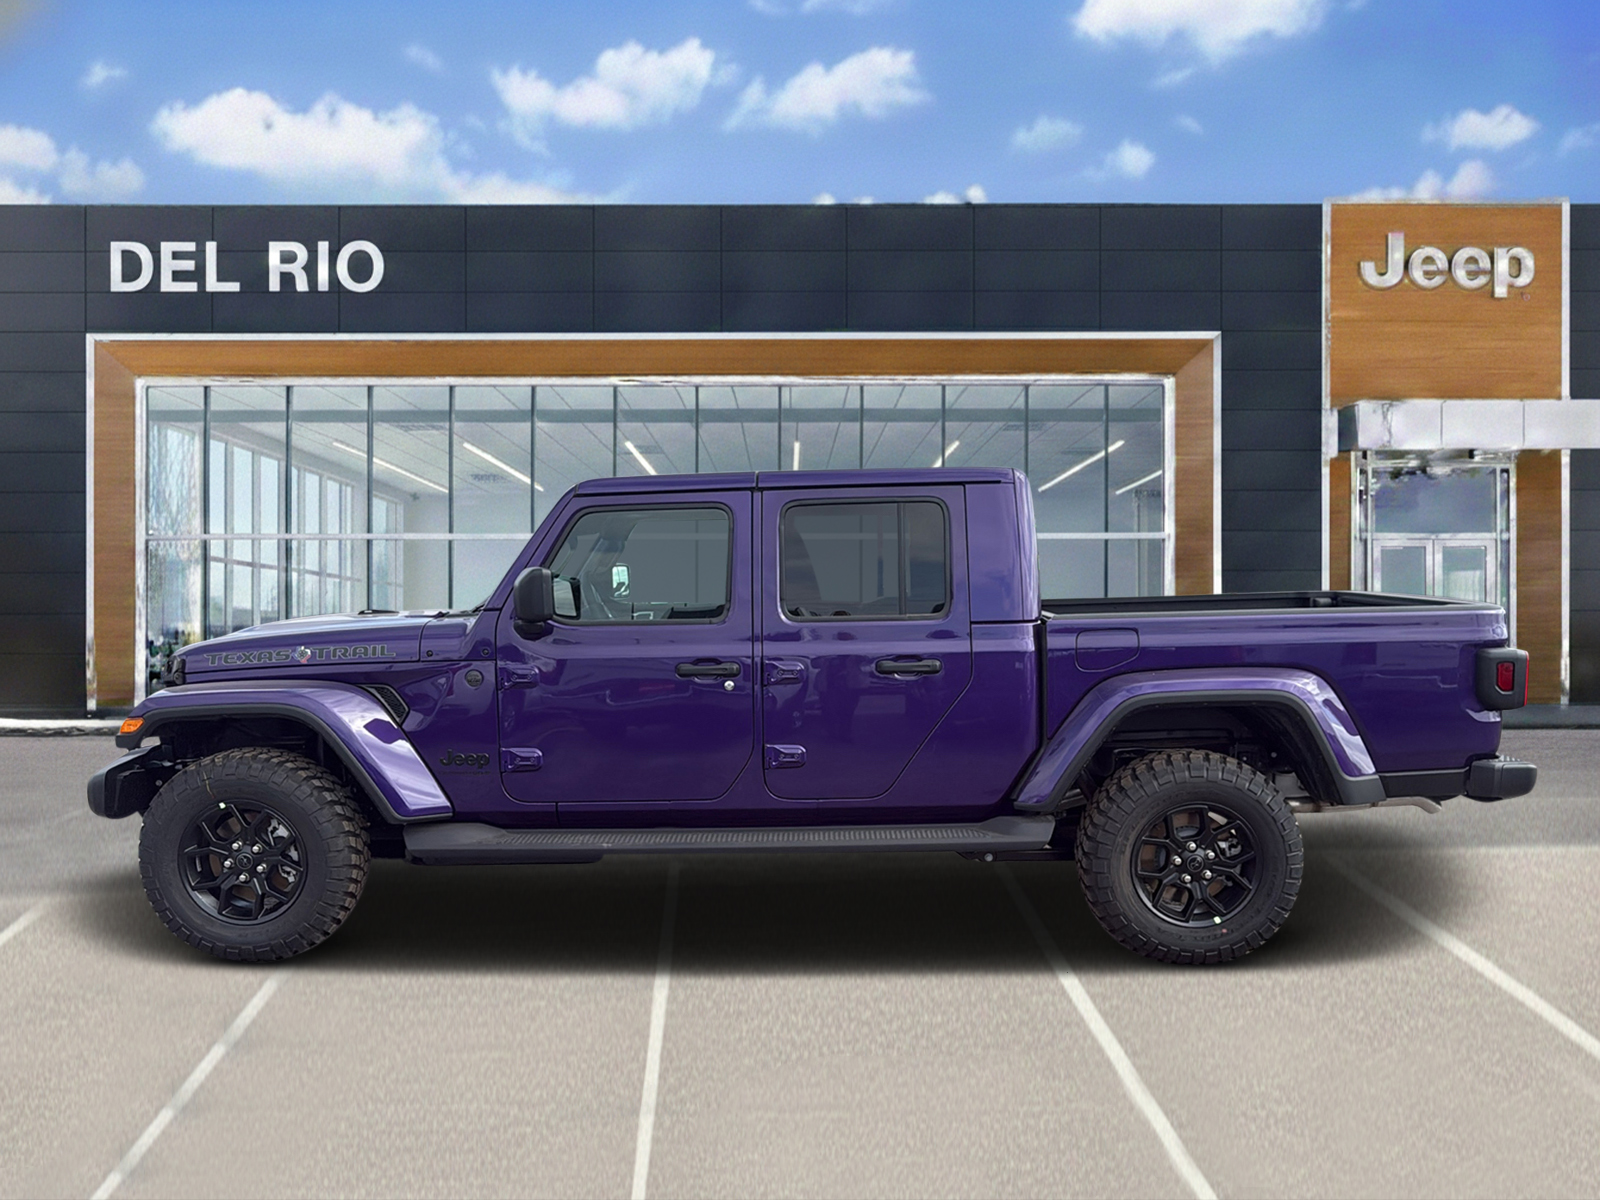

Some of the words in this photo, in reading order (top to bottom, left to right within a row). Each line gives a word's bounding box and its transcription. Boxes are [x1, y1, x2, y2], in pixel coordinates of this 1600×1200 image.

[110, 241, 240, 292] DEL
[268, 240, 385, 293] RIO
[1359, 231, 1535, 298] Jeep
[204, 649, 291, 666] TEXAS
[309, 644, 396, 660] TRAIL
[439, 748, 490, 769] Jeep
